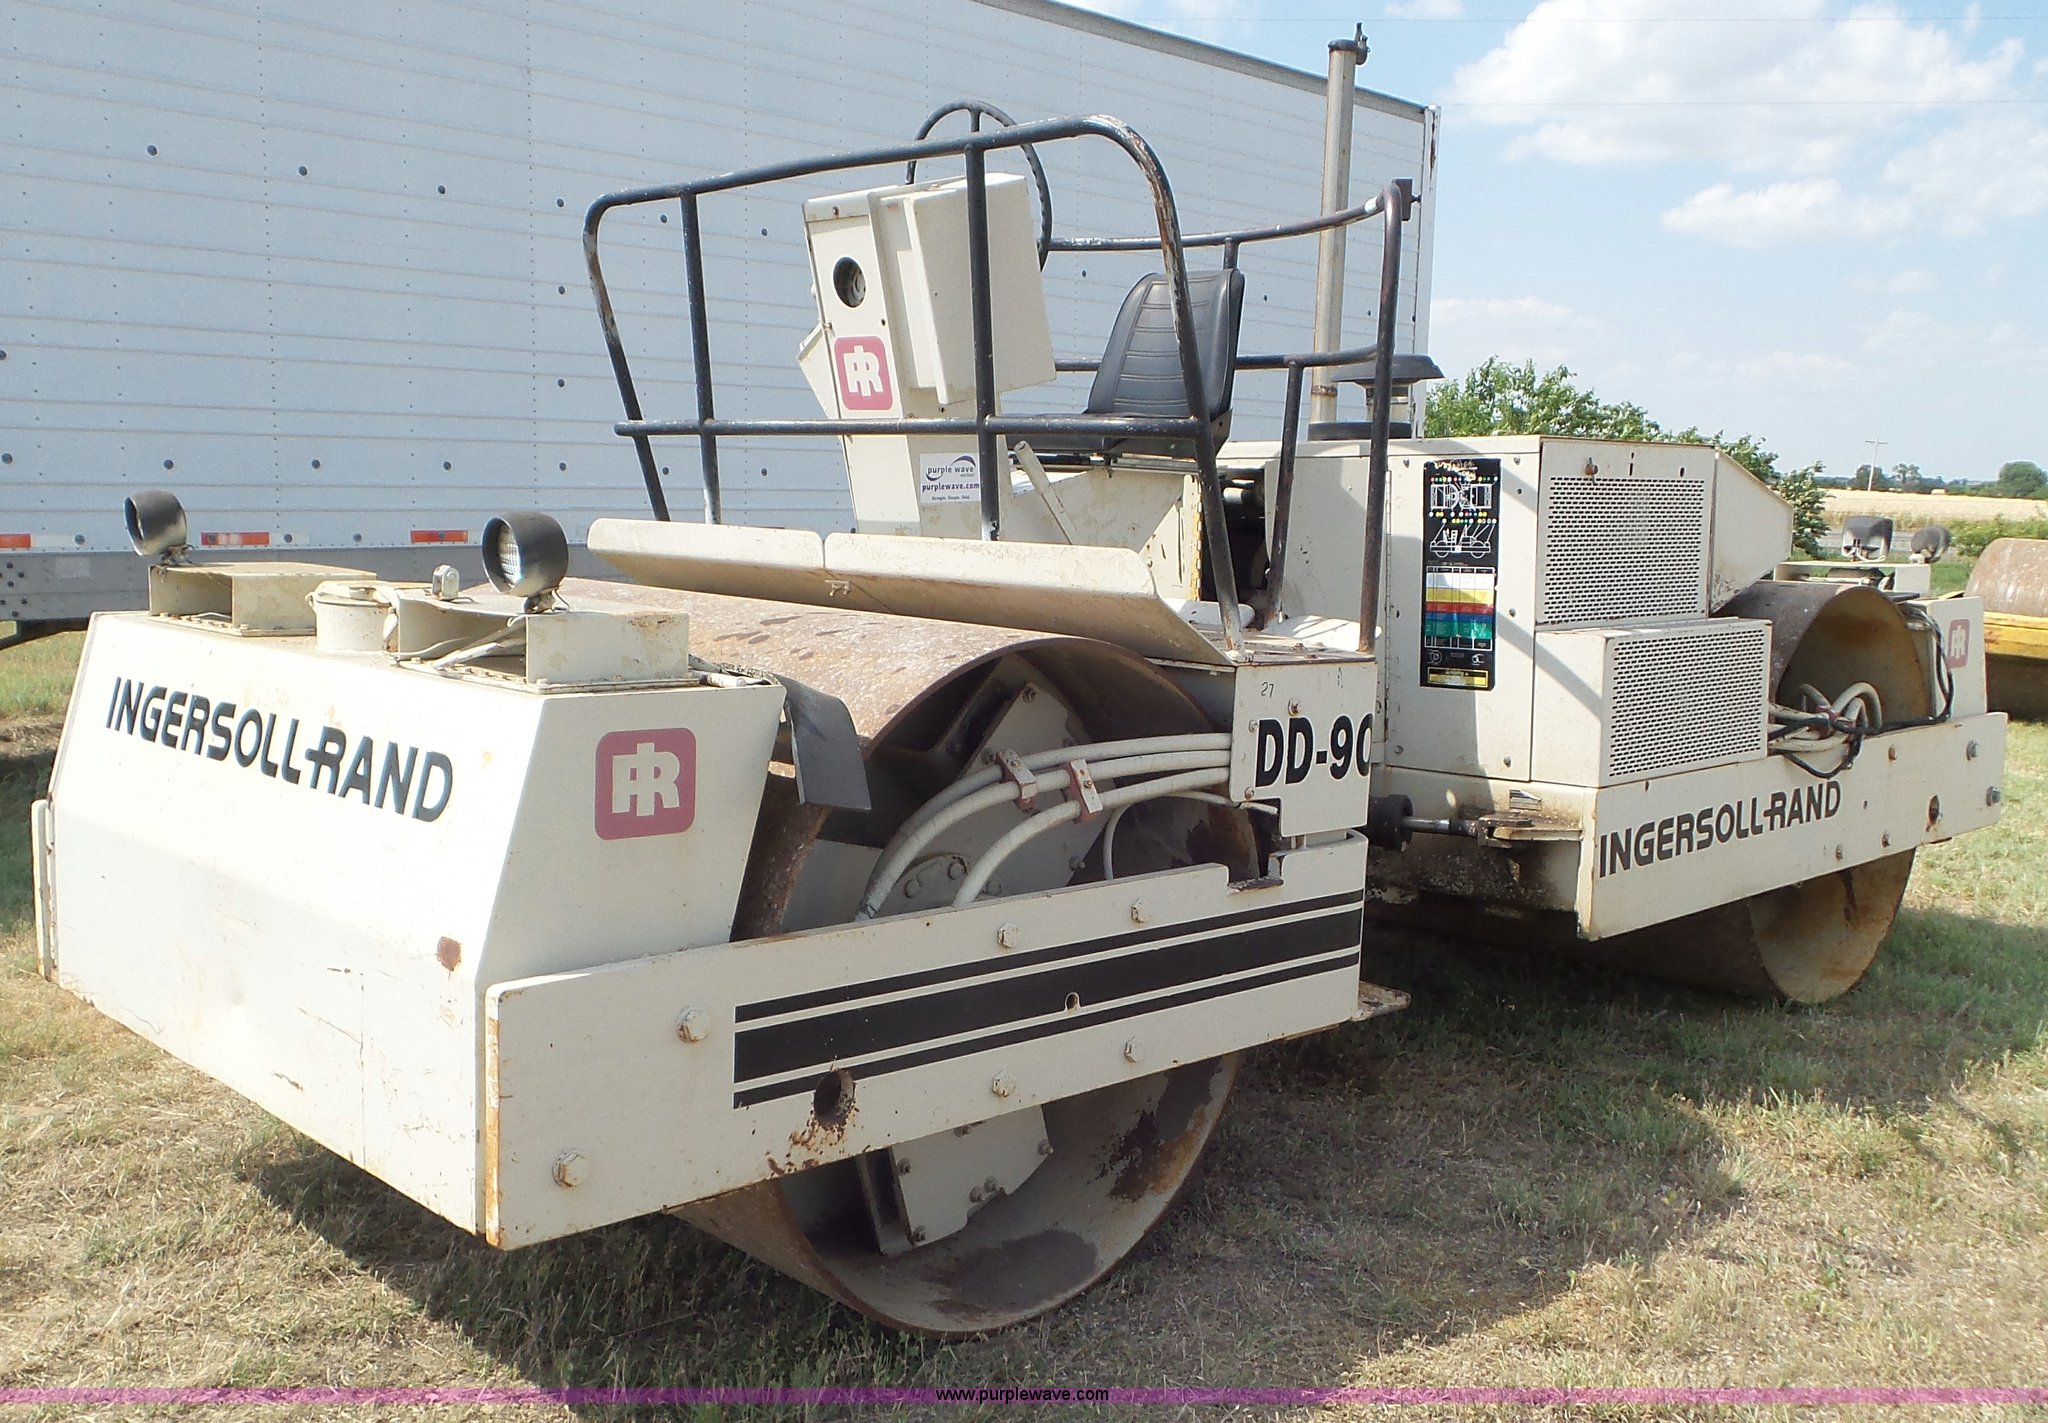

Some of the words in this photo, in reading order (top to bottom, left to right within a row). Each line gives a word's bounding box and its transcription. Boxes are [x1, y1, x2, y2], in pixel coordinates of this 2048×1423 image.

[927, 465, 952, 475] purple
[922, 482, 980, 492] purplewave.com
[1261, 681, 1275, 698] 27
[105, 676, 454, 823] INGERSOLL-RAND
[1599, 780, 1843, 879] INGERSOLL-RAND
